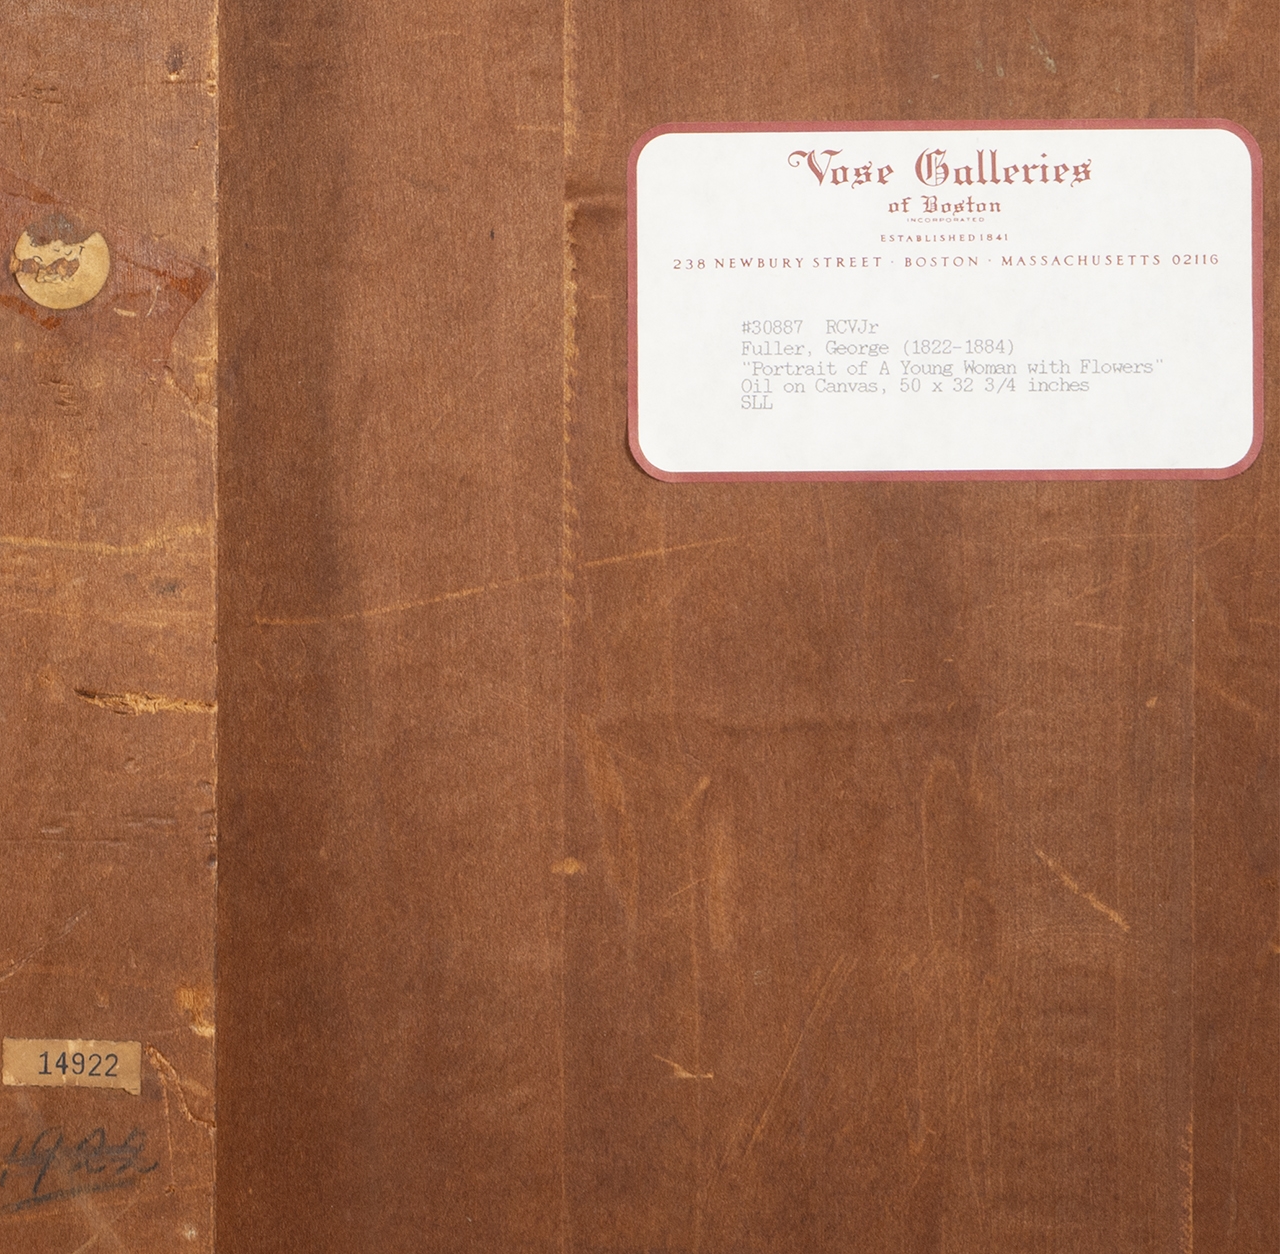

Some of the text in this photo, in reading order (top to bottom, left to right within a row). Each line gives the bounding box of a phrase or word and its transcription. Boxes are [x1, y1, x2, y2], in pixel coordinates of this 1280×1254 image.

[787, 147, 1093, 190] Vose Galleries
[888, 195, 1002, 217] of Boston
[673, 253, 1220, 270] 238 NEWBURY STREET BOSTON MASSACHUSETTS 02116
[741, 319, 880, 335] #30887 RCVJr
[741, 338, 1015, 358] Fuller, George (1822-1884)
[742, 358, 1164, 378] "Portrait of A Young Woman with Flowers"
[741, 377, 1090, 395] Oil on Canvas, 50 x 32 3/4 inches
[740, 394, 774, 410] SLL
[37, 1050, 120, 1078] 14922
